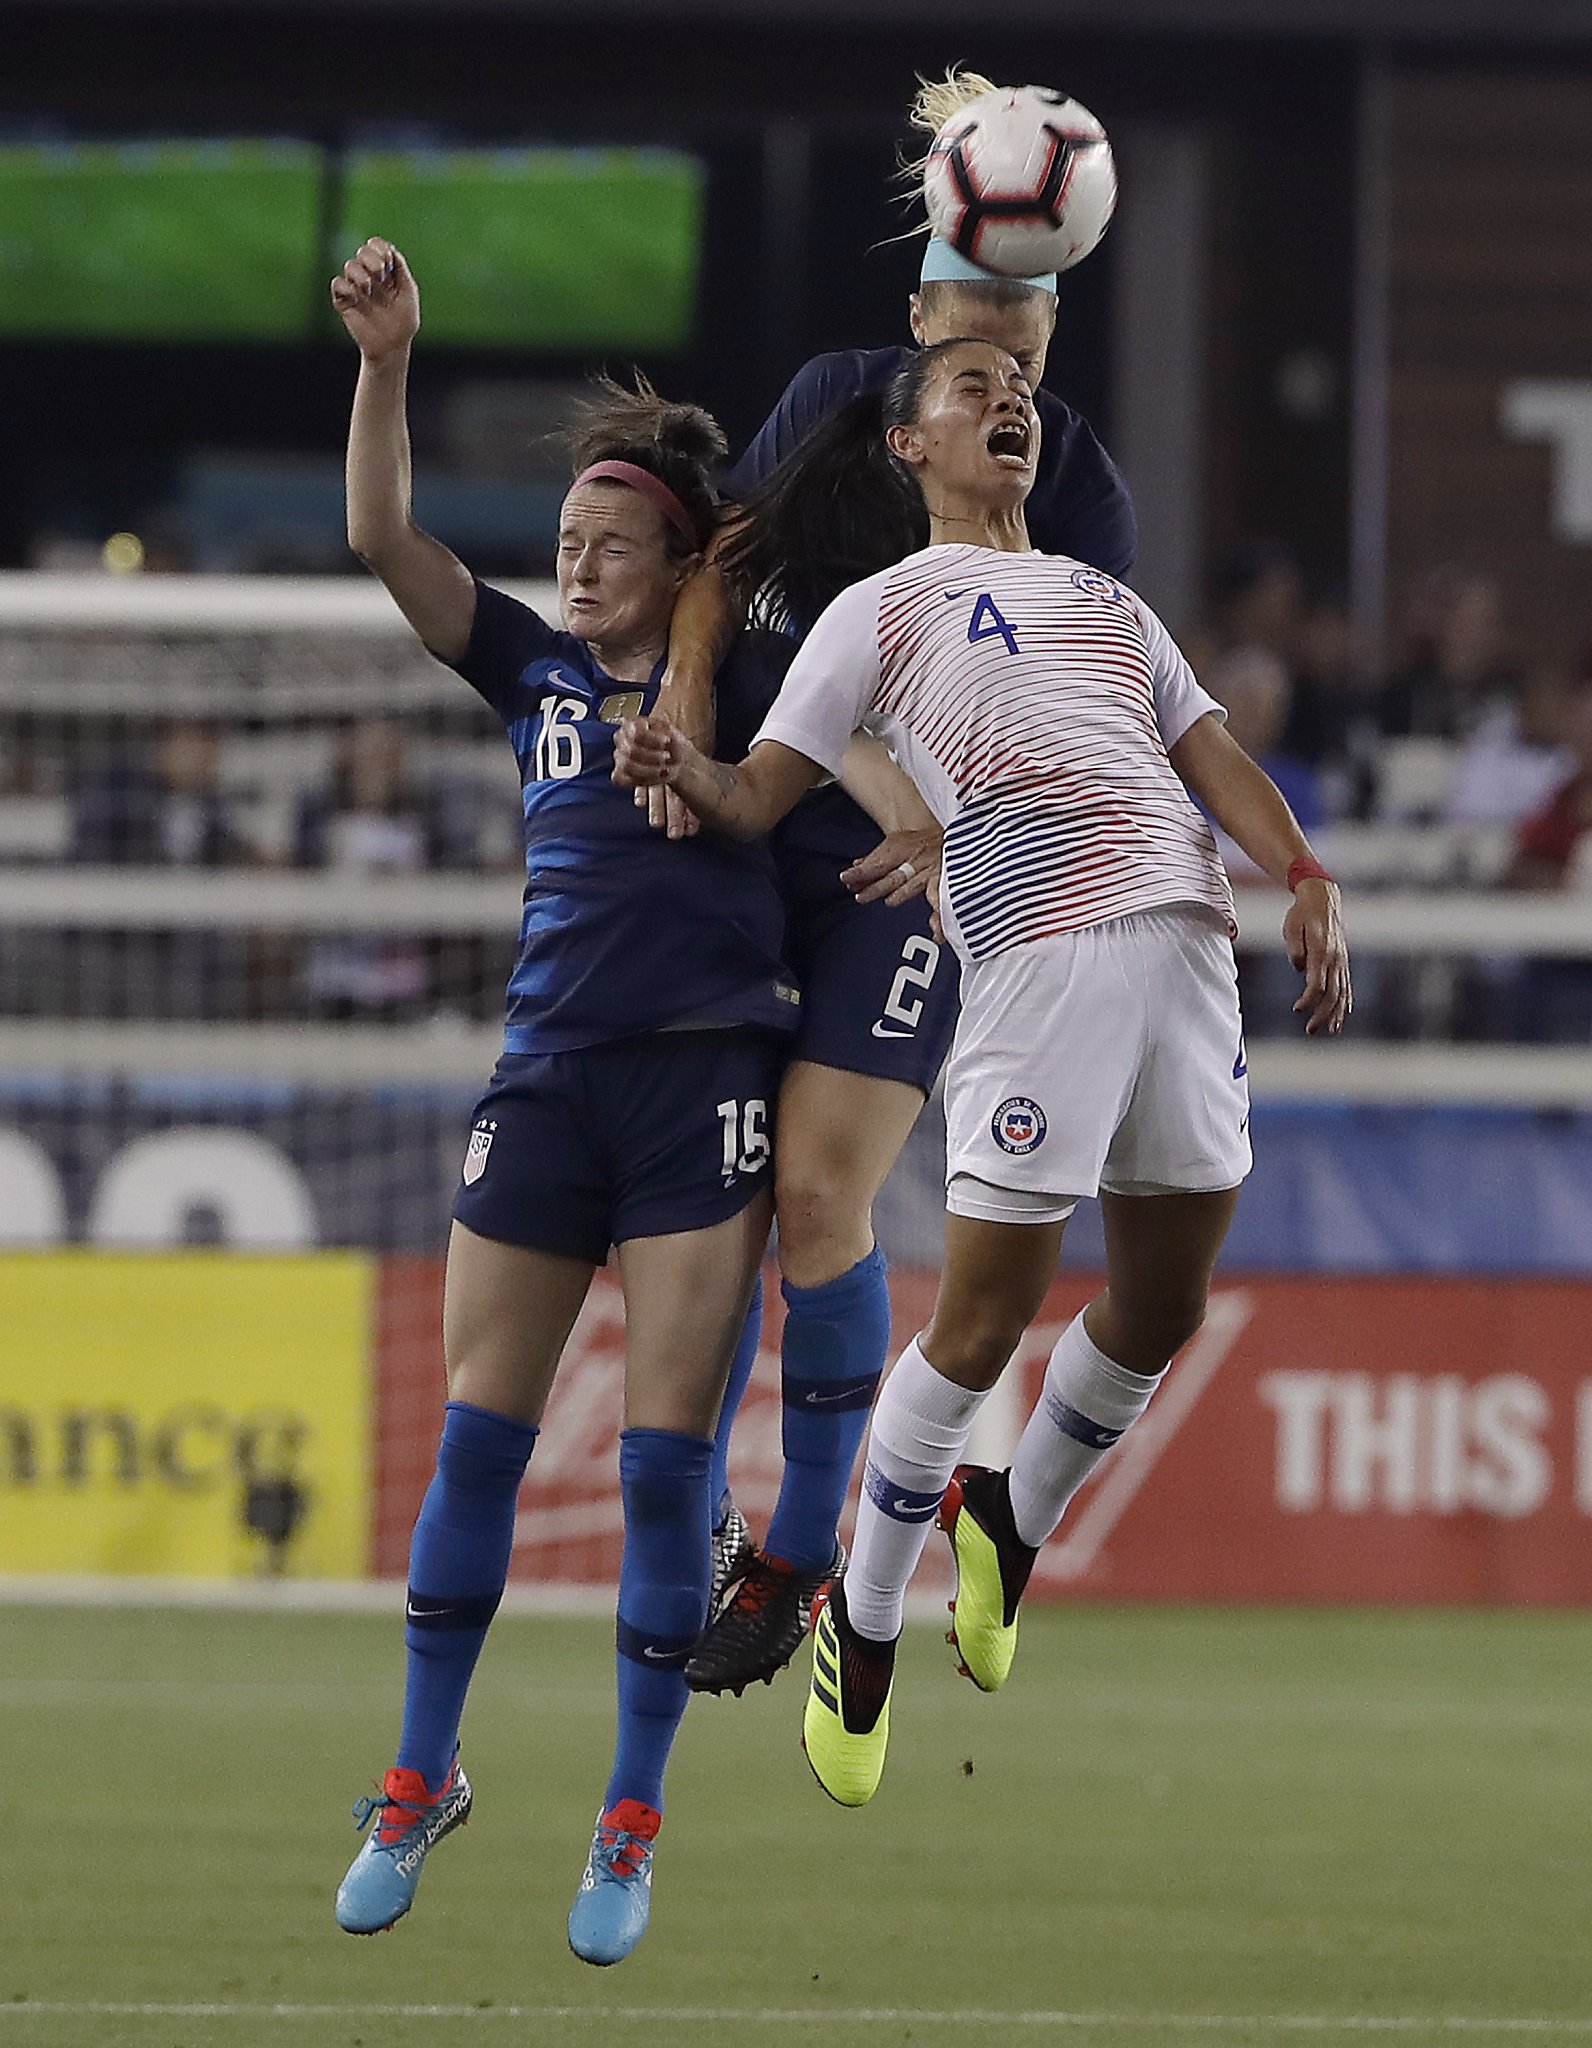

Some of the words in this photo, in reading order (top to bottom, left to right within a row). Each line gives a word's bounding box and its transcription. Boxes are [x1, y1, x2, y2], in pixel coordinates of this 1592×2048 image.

[967, 593, 1021, 655] 4
[536, 695, 588, 781] 16
[884, 934, 940, 1028] 2
[717, 1099, 770, 1173] 16
[1258, 1372, 1550, 1516] THIS
[395, 1839, 426, 1877] new
[426, 1782, 472, 1843] balance
